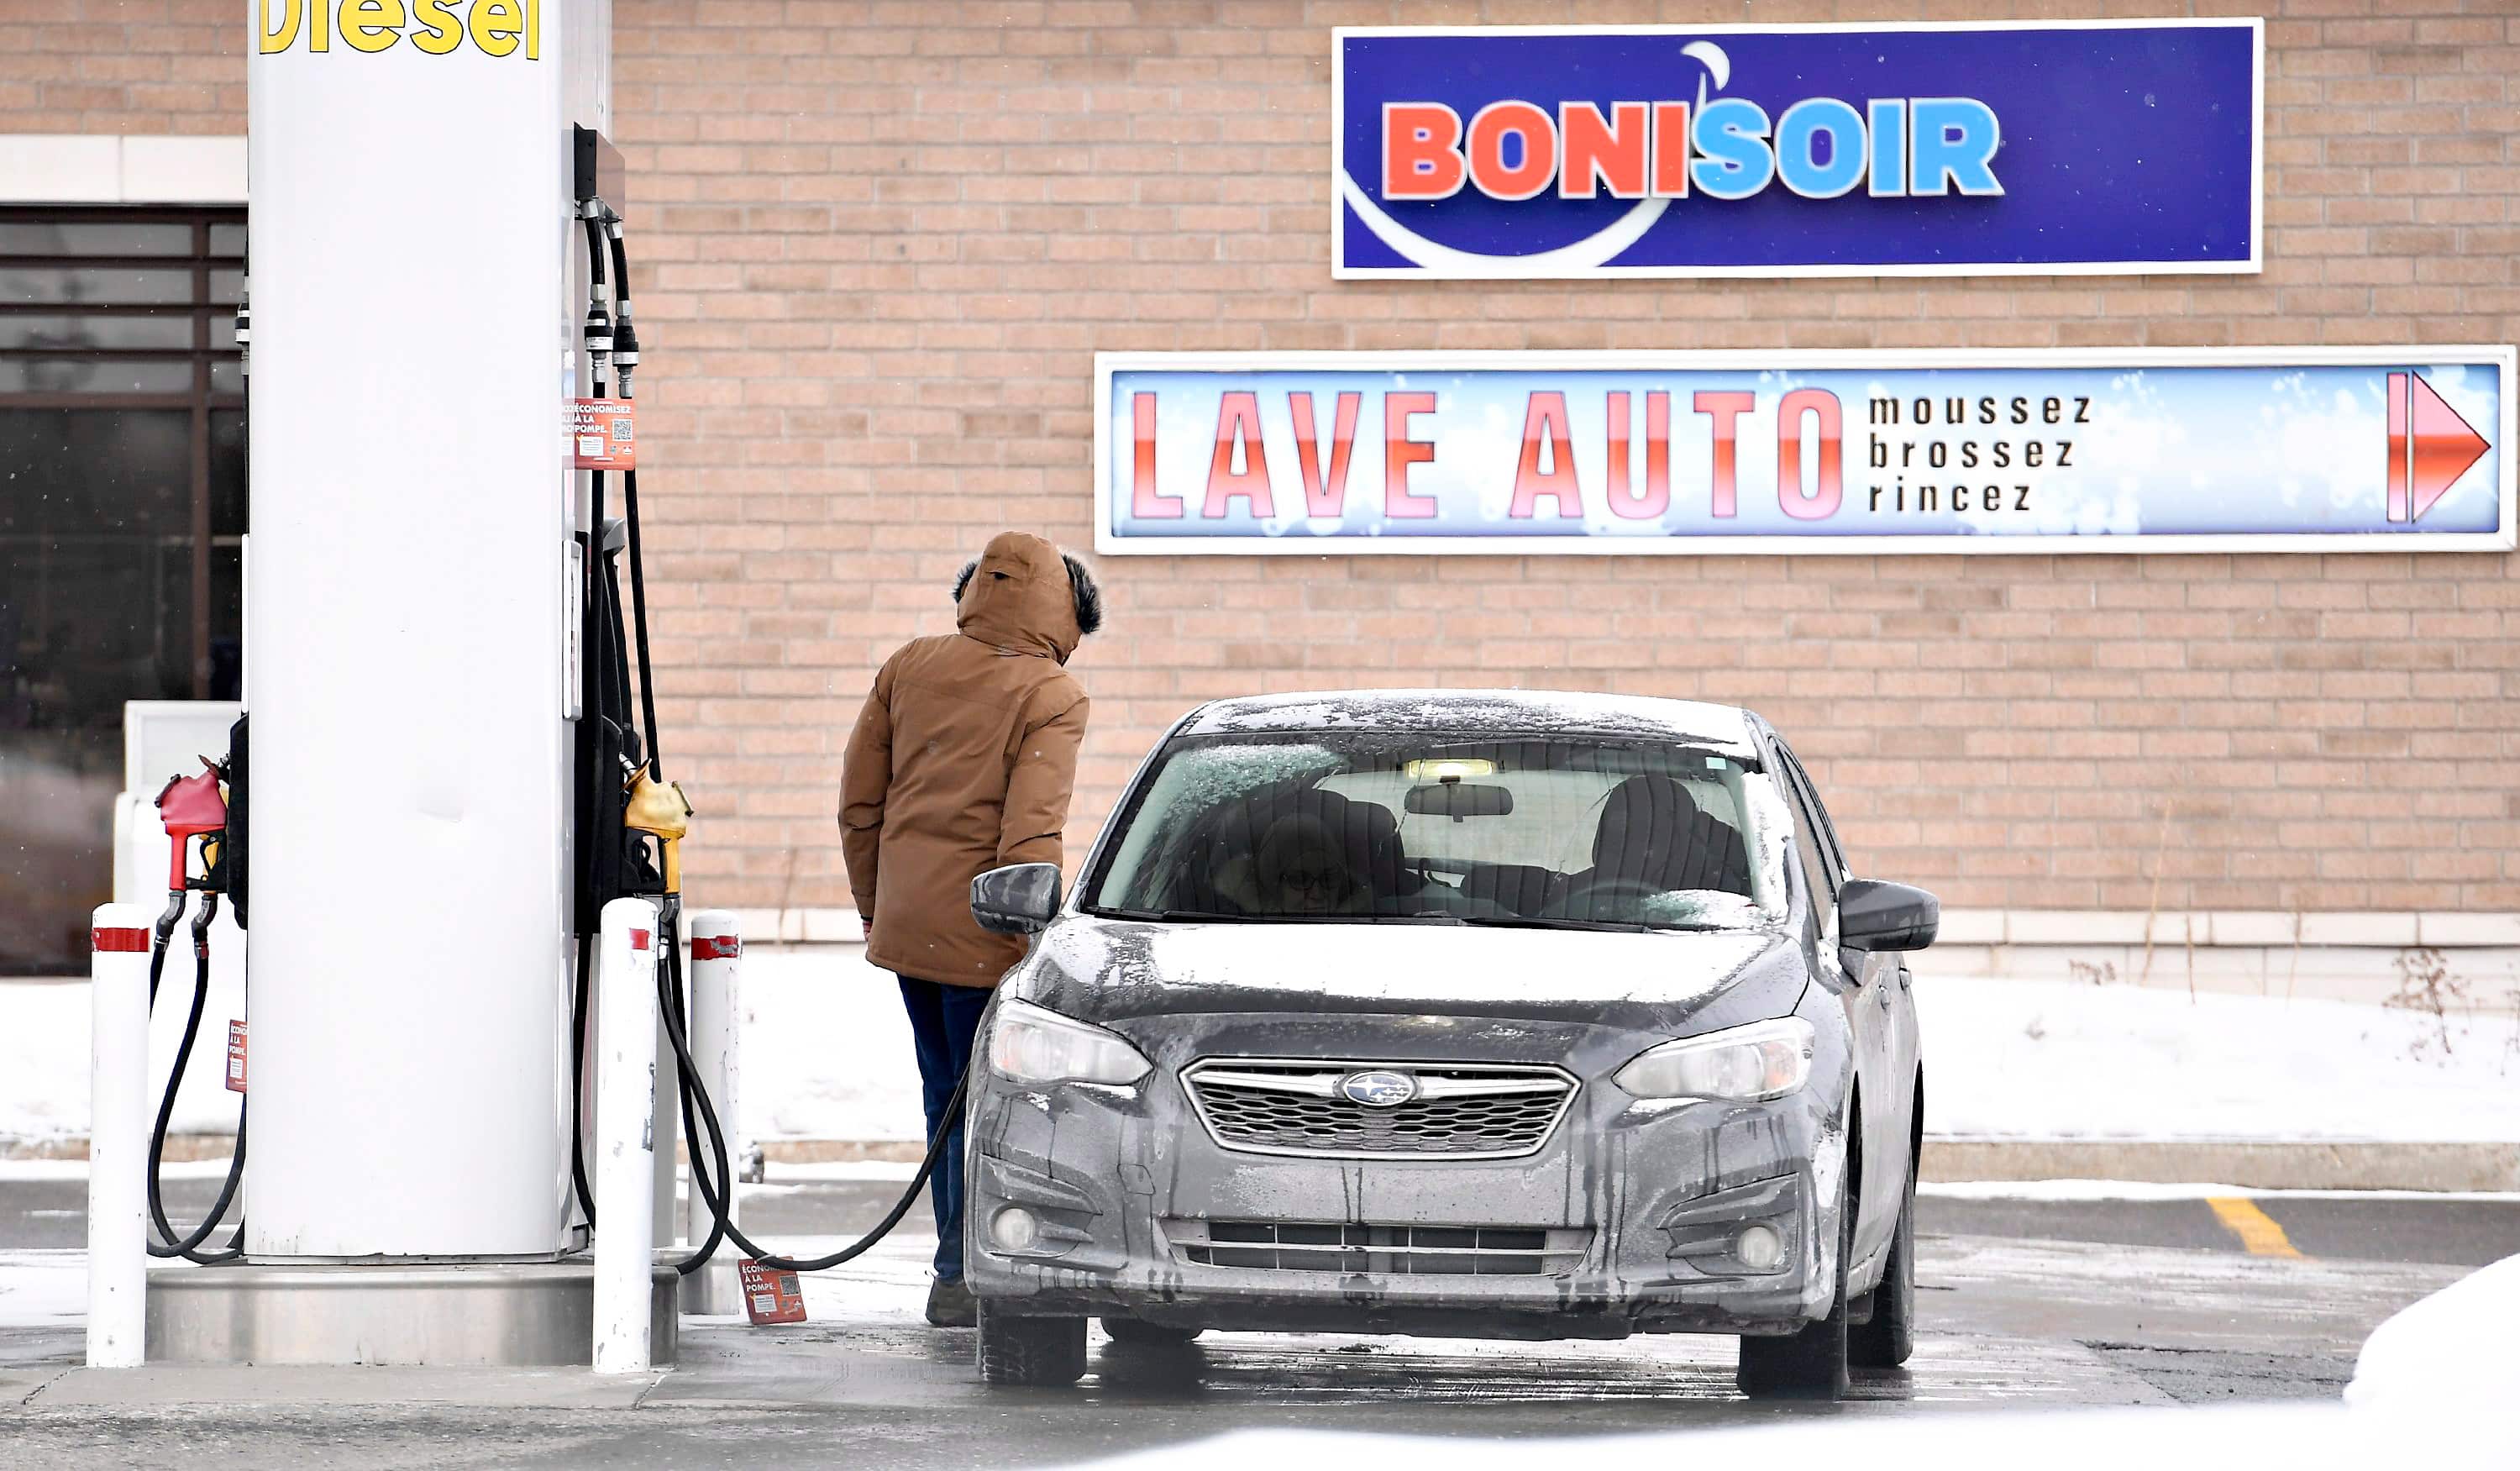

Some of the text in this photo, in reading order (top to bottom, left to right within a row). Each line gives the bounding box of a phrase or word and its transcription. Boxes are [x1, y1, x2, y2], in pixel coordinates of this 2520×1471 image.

[259, 0, 539, 60] Diesel
[583, 415, 595, 423] LA
[1870, 397, 2090, 424] moussez
[1130, 386, 1843, 520] LAVE AUTO
[1870, 433, 2072, 468] brossez
[1870, 475, 2029, 512] rincez
[752, 1274, 763, 1282] LA
